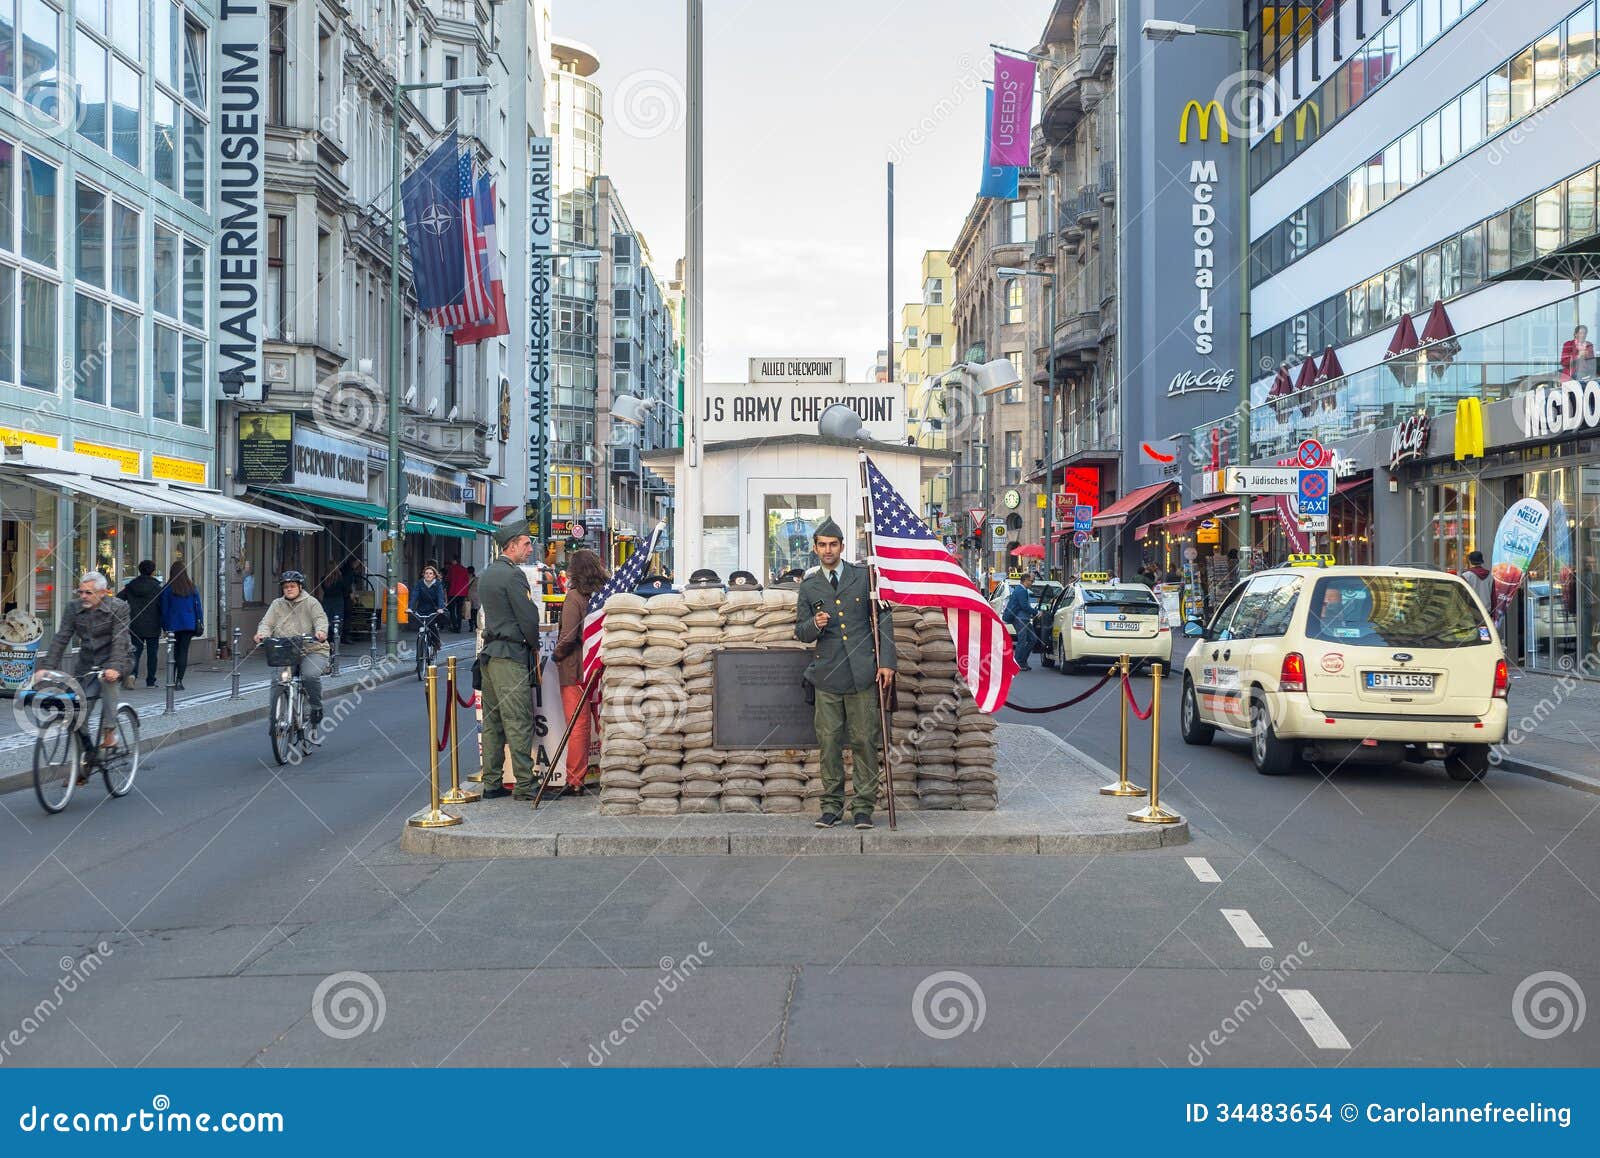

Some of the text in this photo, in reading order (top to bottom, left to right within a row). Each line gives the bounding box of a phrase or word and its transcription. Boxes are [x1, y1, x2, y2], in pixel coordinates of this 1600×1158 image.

[219, 43, 259, 383] MAUERMUSEUM
[530, 144, 550, 493] HAUS AM CHECKPOINT CHARLIE
[761, 361, 833, 377] ALLIED CHECKPOINT
[733, 396, 783, 423] ARMY
[294, 444, 337, 479] HECKPOINT
[337, 454, 365, 485] CHARLIE
[1250, 475, 1289, 485] Jüdisches
[1300, 500, 1327, 512] TAXI
[1523, 504, 1540, 515] JETZT
[1516, 508, 1543, 527] NEU!
[1076, 522, 1091, 530] TAXI
[1374, 674, 1432, 686] B TA 1563
